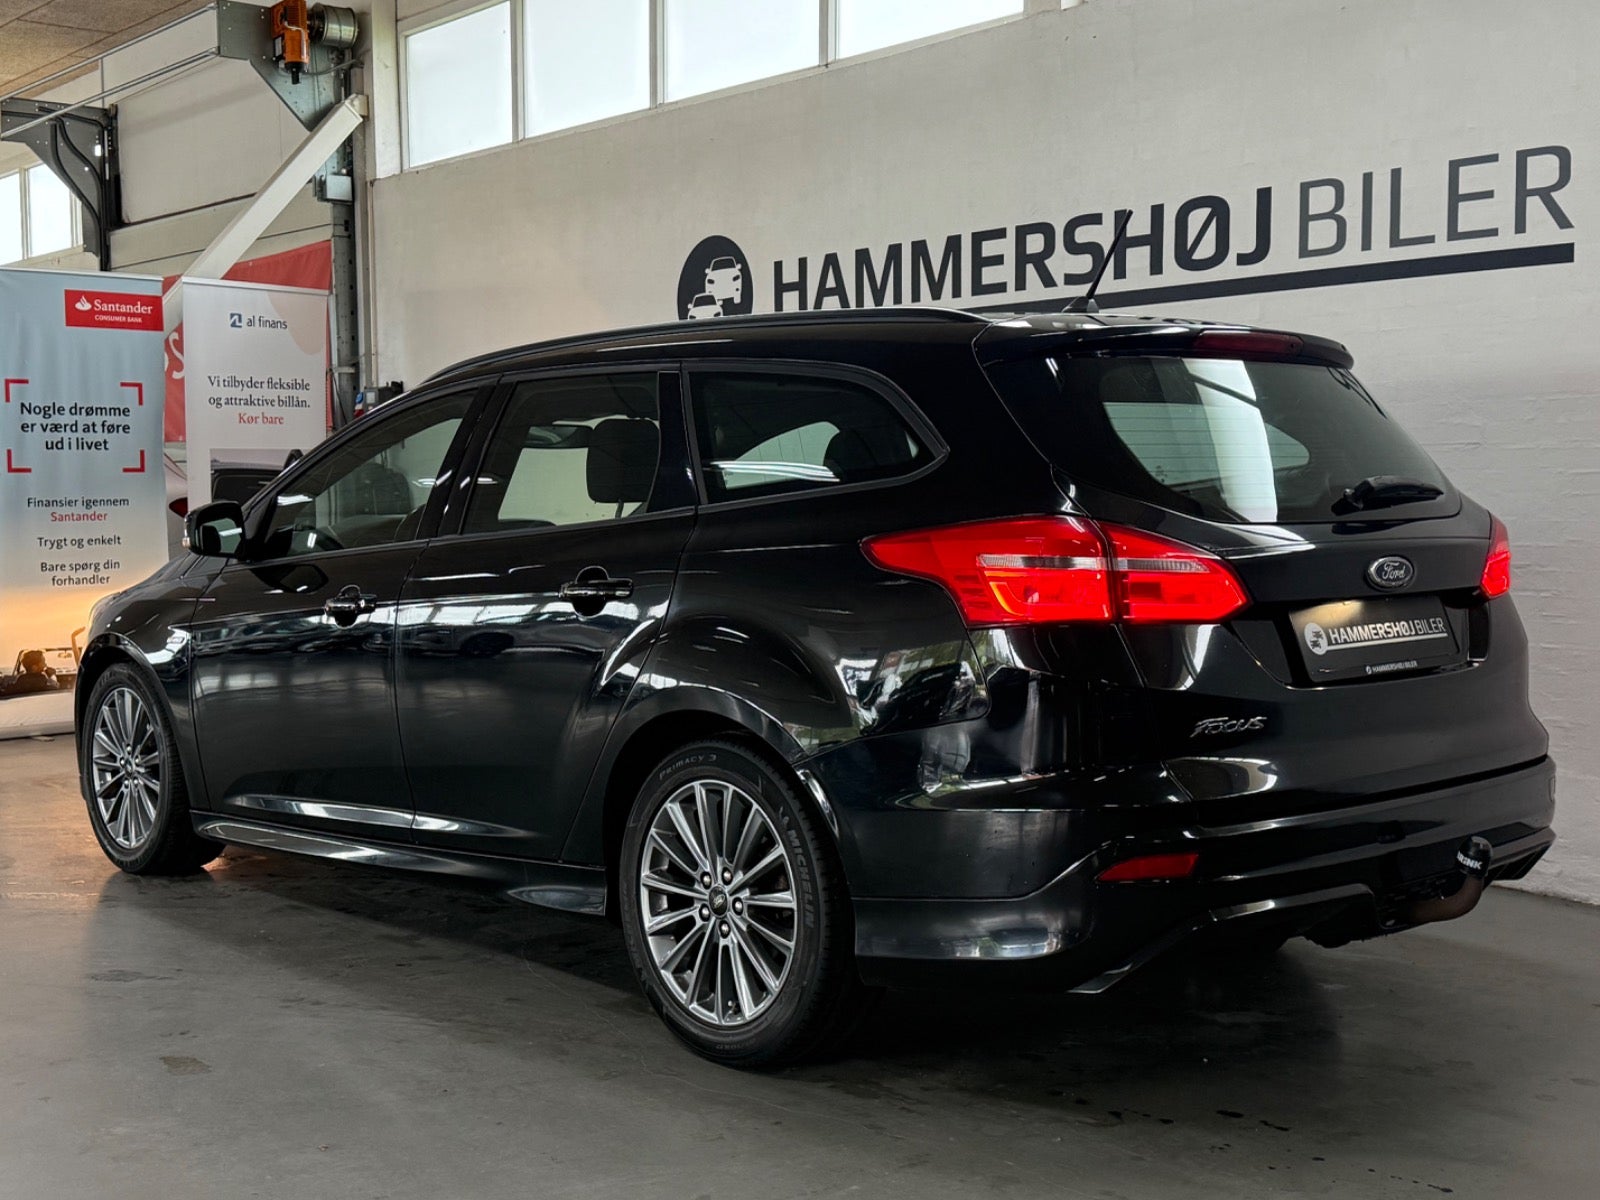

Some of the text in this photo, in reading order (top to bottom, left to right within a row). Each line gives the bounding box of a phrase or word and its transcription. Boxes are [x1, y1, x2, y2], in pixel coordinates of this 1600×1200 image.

[773, 145, 1575, 312] HAMMERSHØJ BILER
[93, 298, 153, 314] Santander
[94, 314, 126, 322] CONSUMER
[246, 316, 288, 330] al finans
[207, 375, 311, 391] Vi tilbyder fleksible
[208, 395, 311, 409] og attraktive billån.
[20, 402, 131, 419] Nogle drømme
[238, 412, 284, 425] Kør bare
[20, 420, 131, 434] er værd at føre
[45, 437, 109, 451] ud i livet
[27, 497, 130, 510] Finansier igennem
[50, 511, 108, 522] Santander
[37, 535, 121, 550] Trygt og enkelt
[40, 559, 120, 574] Bare spørg din
[1382, 561, 1407, 580] Ford
[51, 575, 111, 587] forhandler
[1328, 617, 1447, 644] HAMMERSHØJ BILER
[787, 829, 814, 928] MICHELIN
